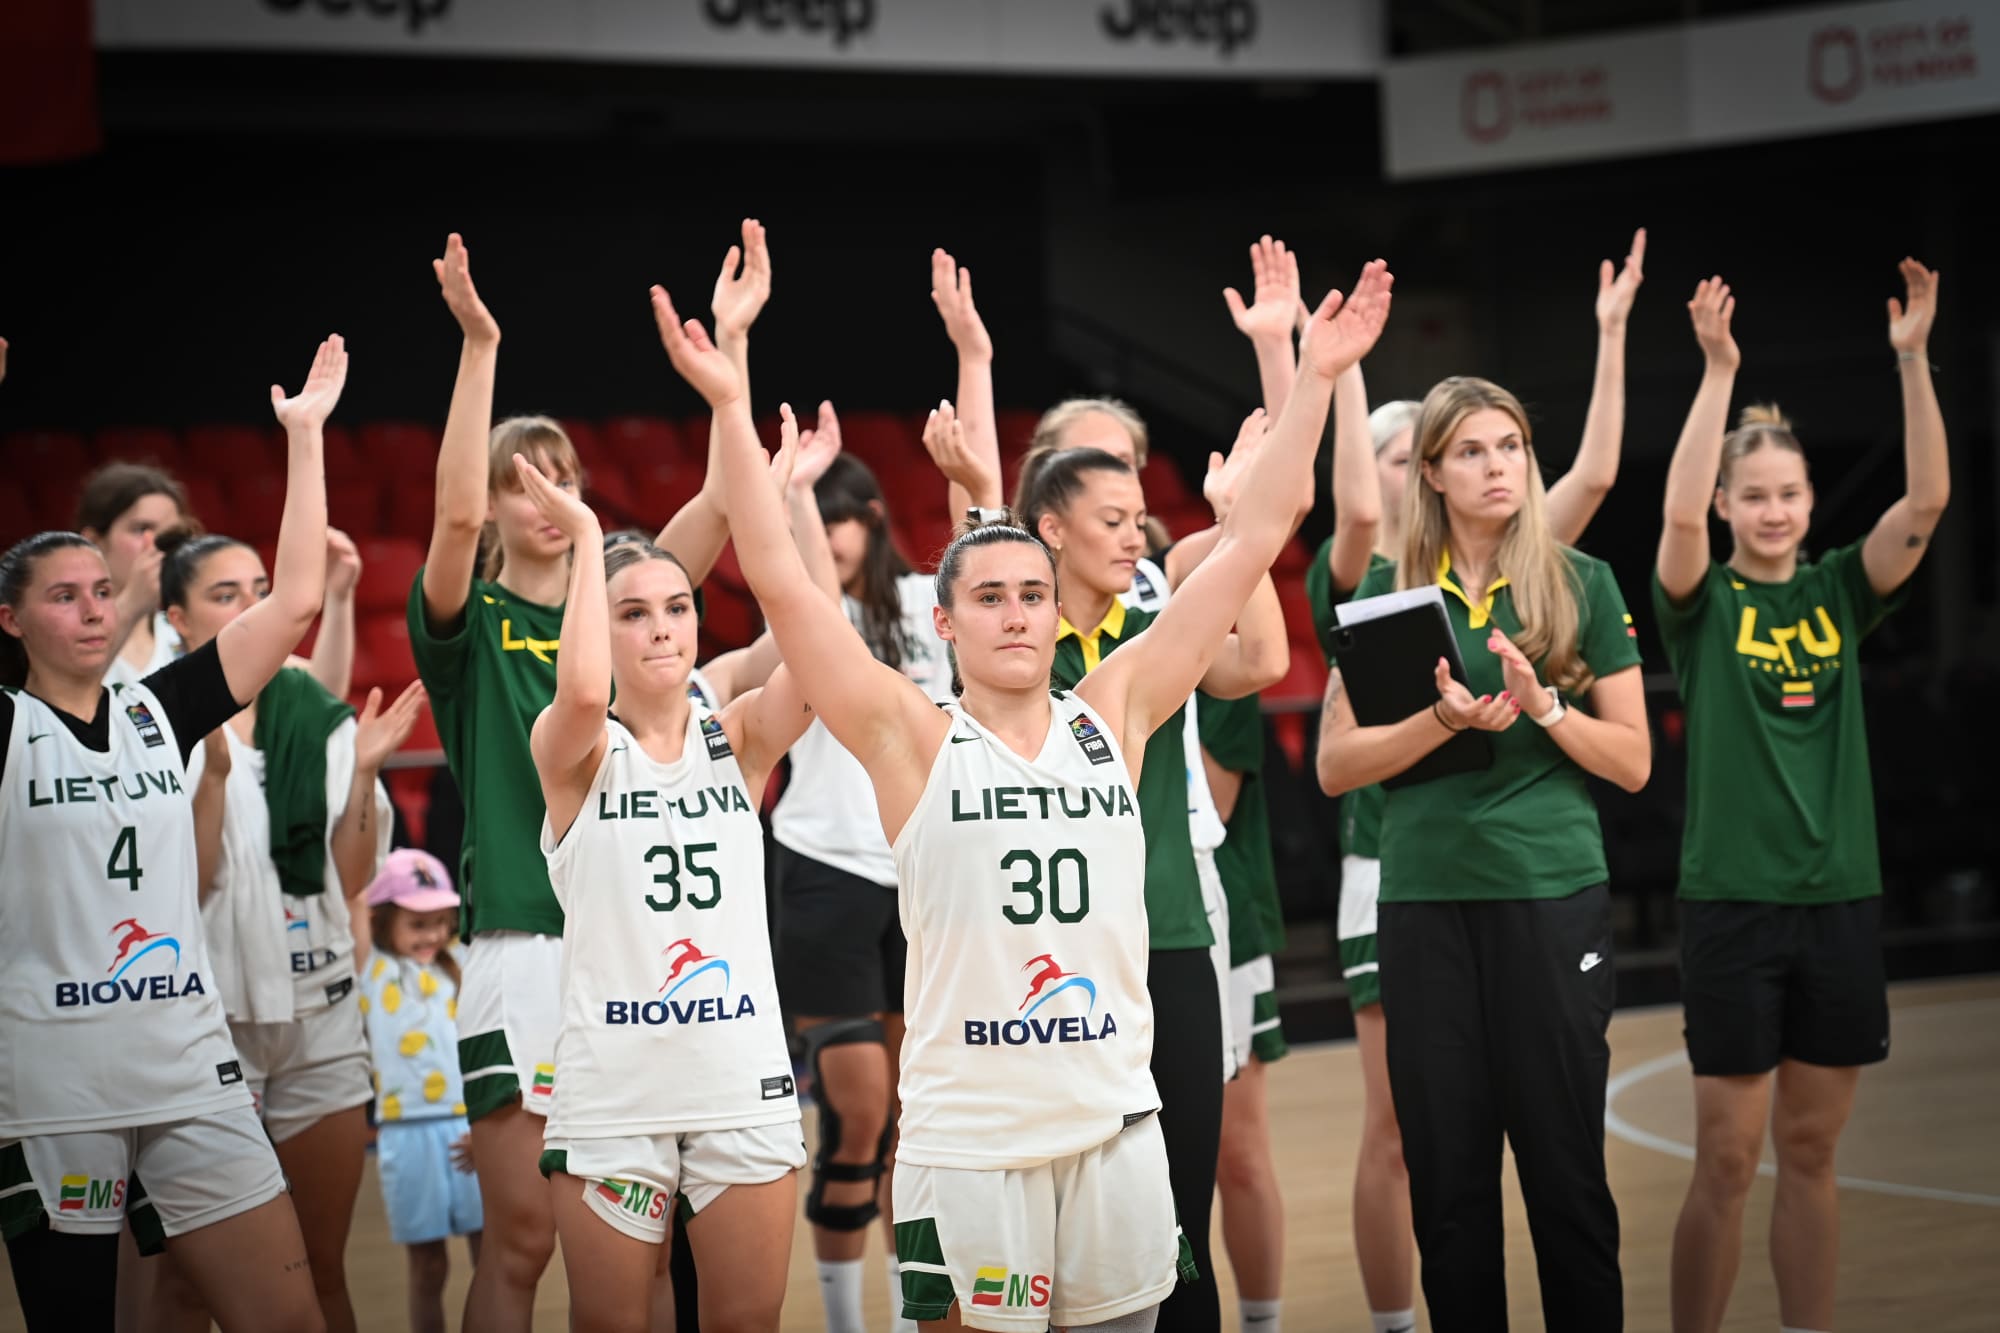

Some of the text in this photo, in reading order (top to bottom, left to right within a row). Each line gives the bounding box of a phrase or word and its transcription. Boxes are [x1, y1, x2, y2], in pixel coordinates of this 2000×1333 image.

[1098, 0, 1258, 58] Jeep
[29, 769, 184, 807] LIETUVA
[951, 784, 1135, 822] LIETUVA
[107, 826, 143, 891] 4
[644, 842, 722, 912] 35
[1000, 848, 1090, 925] 30
[55, 972, 205, 1007] BIOVELA
[605, 994, 756, 1025] BIOVELA
[964, 1012, 1117, 1046] BIOVELA
